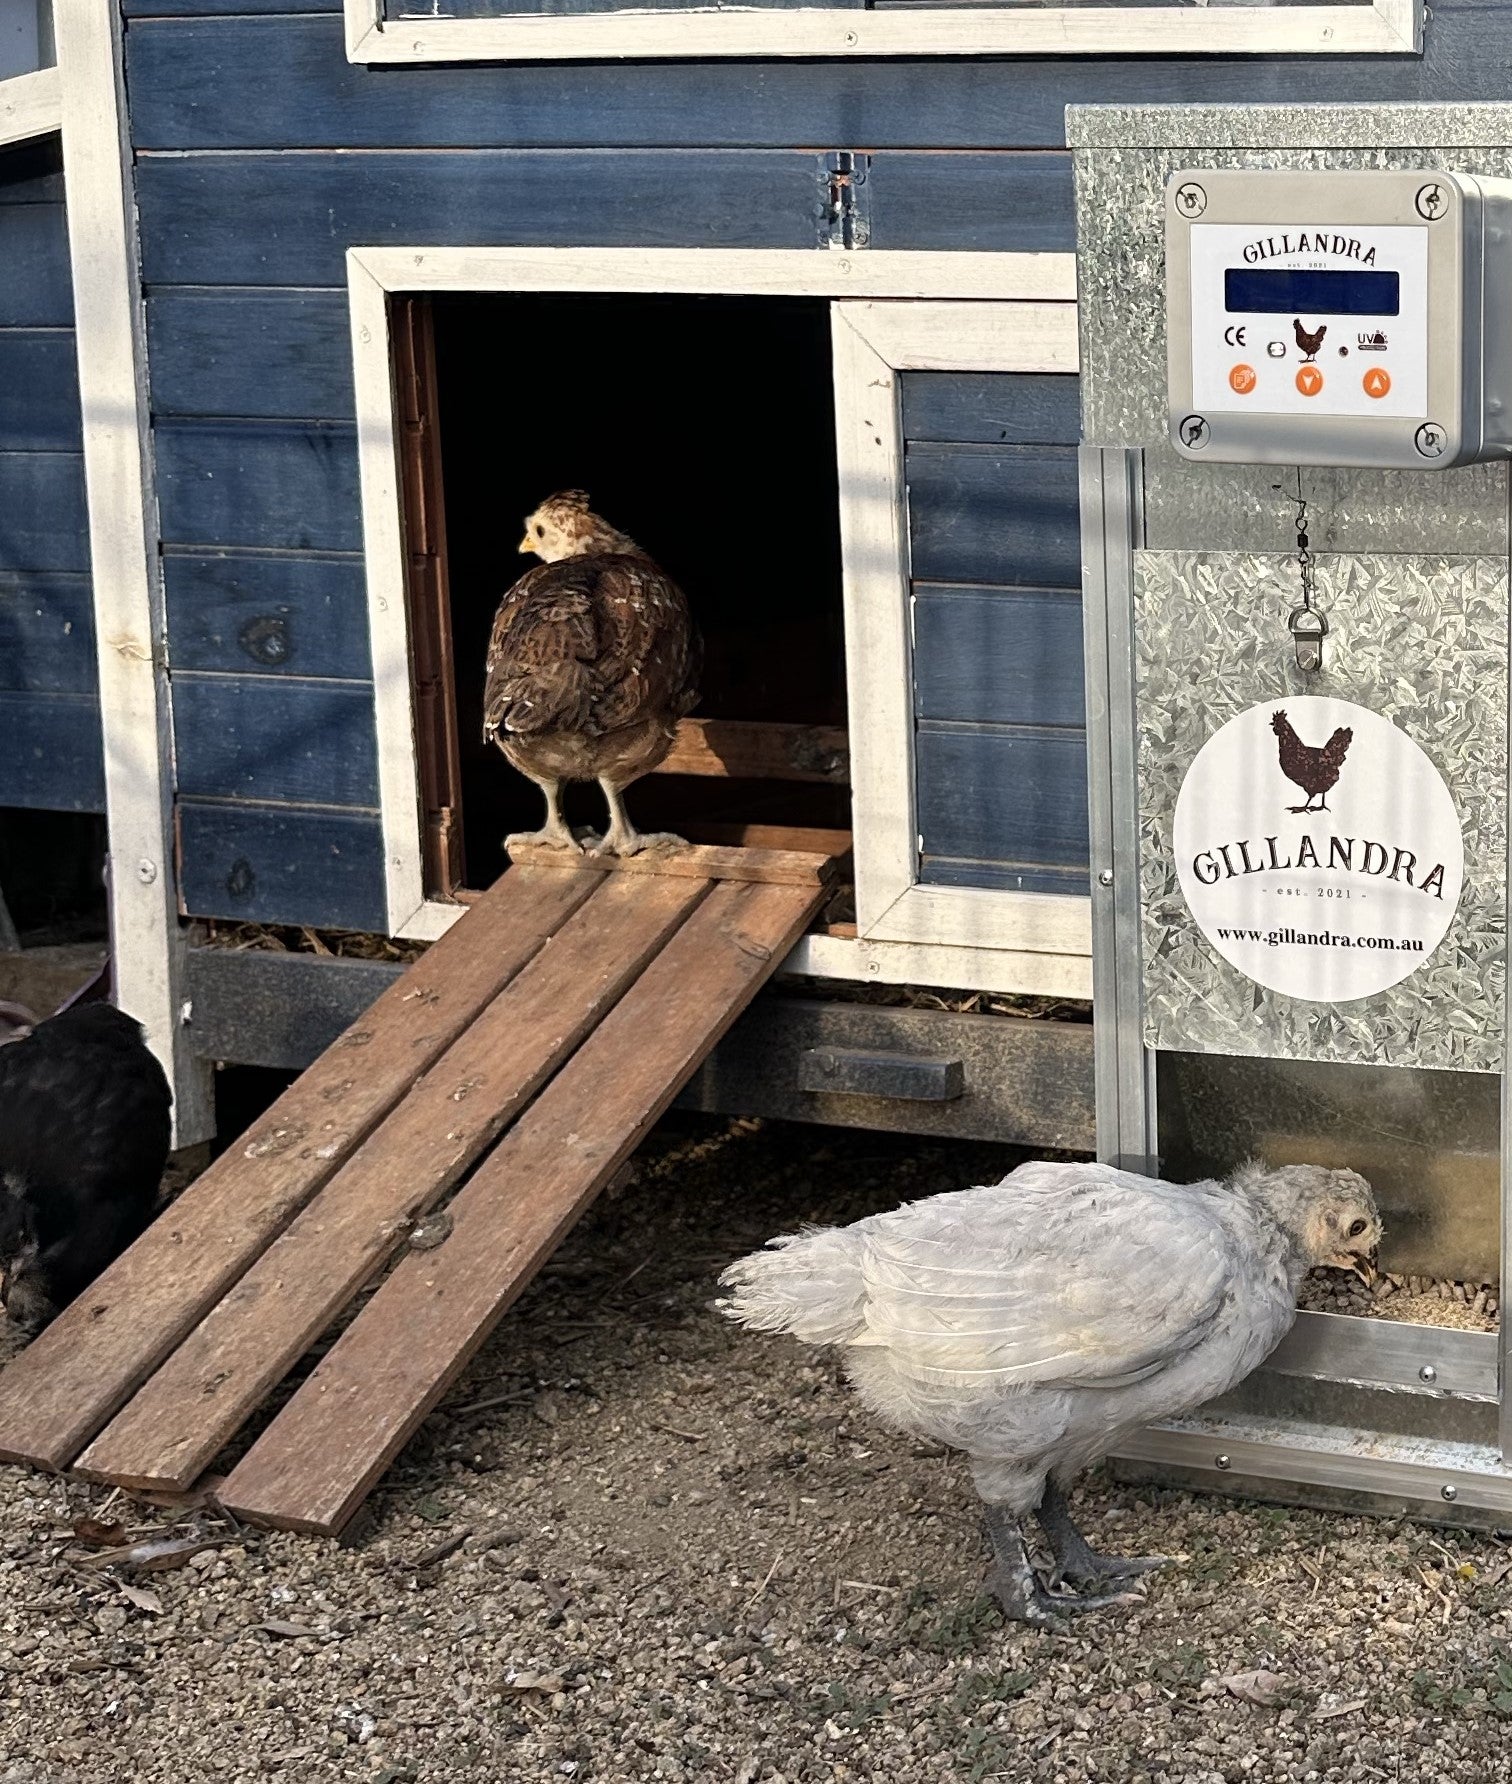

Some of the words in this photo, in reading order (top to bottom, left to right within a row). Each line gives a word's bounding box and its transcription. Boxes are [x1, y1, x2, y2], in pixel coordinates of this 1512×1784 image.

[1243, 233, 1376, 267] GILLANDRA
[1224, 326, 1246, 346] CE
[1193, 835, 1446, 900] GILLANDRA
[1276, 887, 1309, 897] est.
[1317, 887, 1352, 899] 2021
[1217, 927, 1424, 951] www.gillandra.com.au
